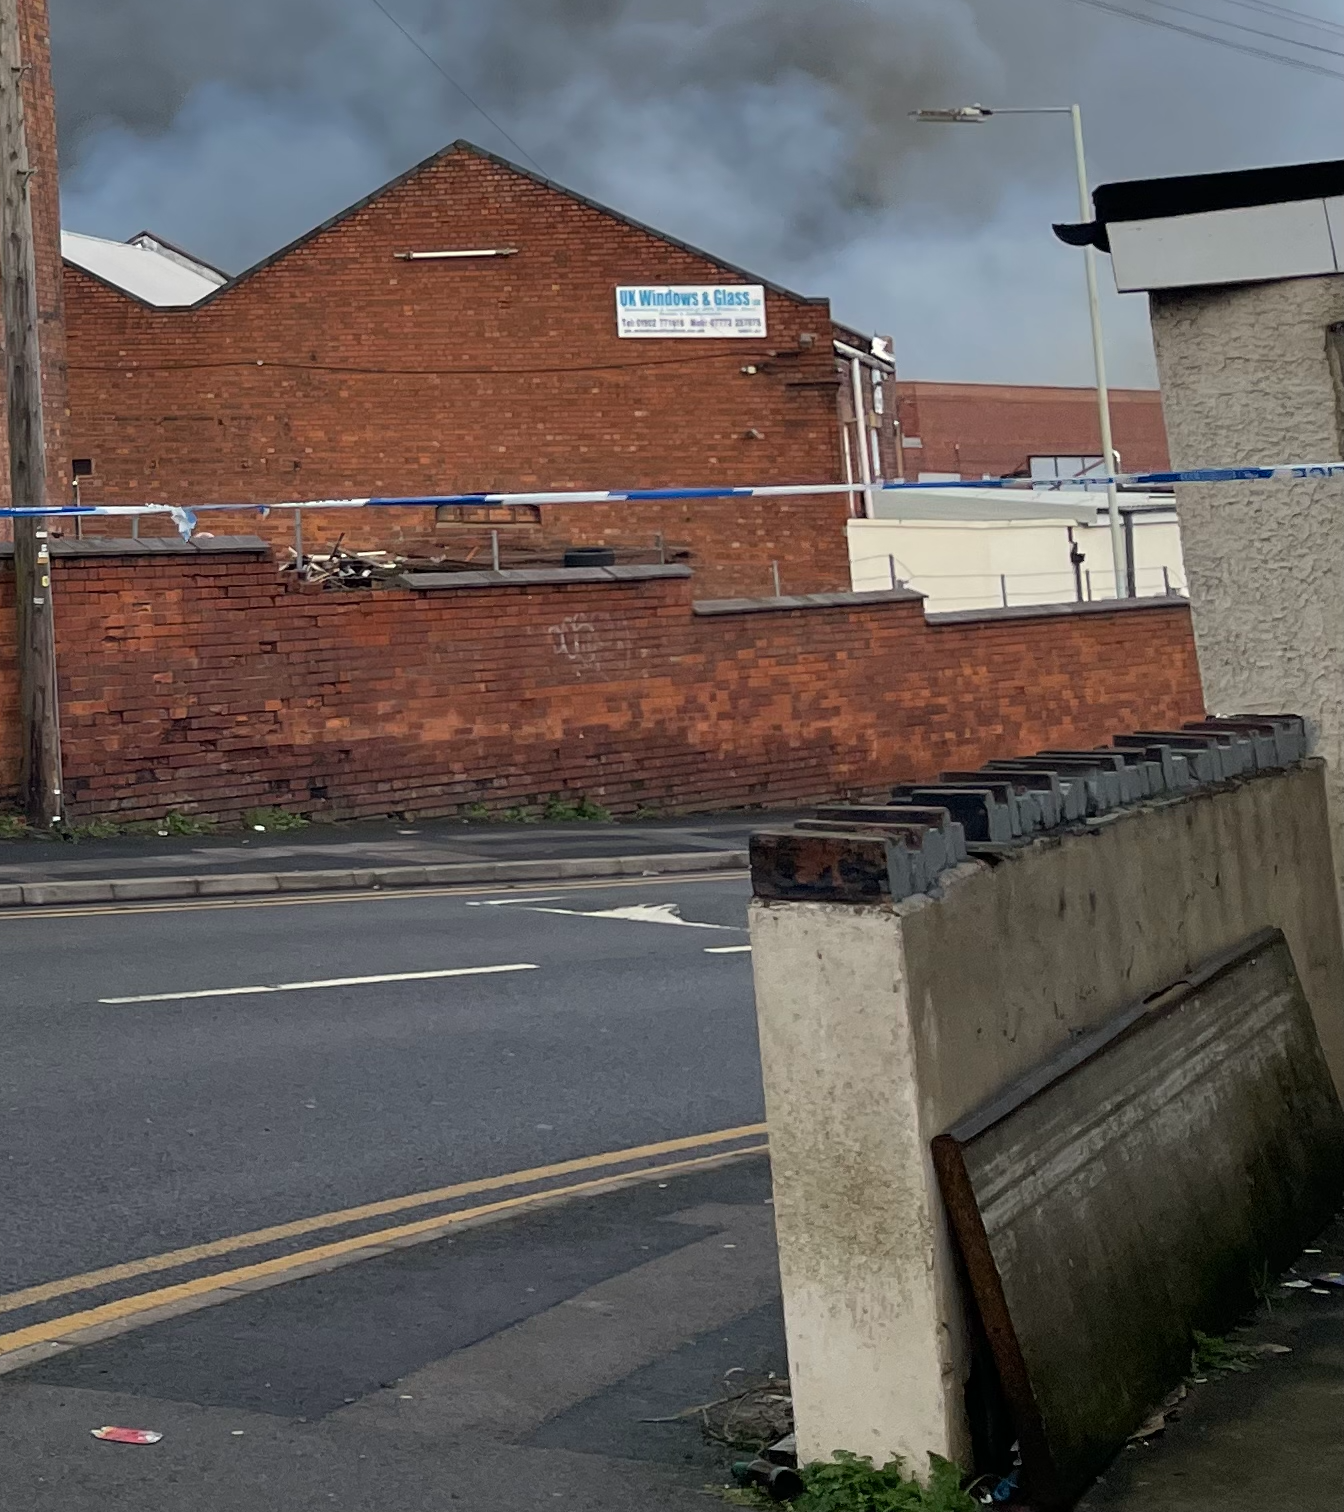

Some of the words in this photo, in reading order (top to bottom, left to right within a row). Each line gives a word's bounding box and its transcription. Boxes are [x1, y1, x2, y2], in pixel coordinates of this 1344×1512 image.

[619, 290, 636, 306] UK
[639, 289, 698, 306] Windows
[702, 291, 710, 306] &
[714, 289, 750, 306] Glass
